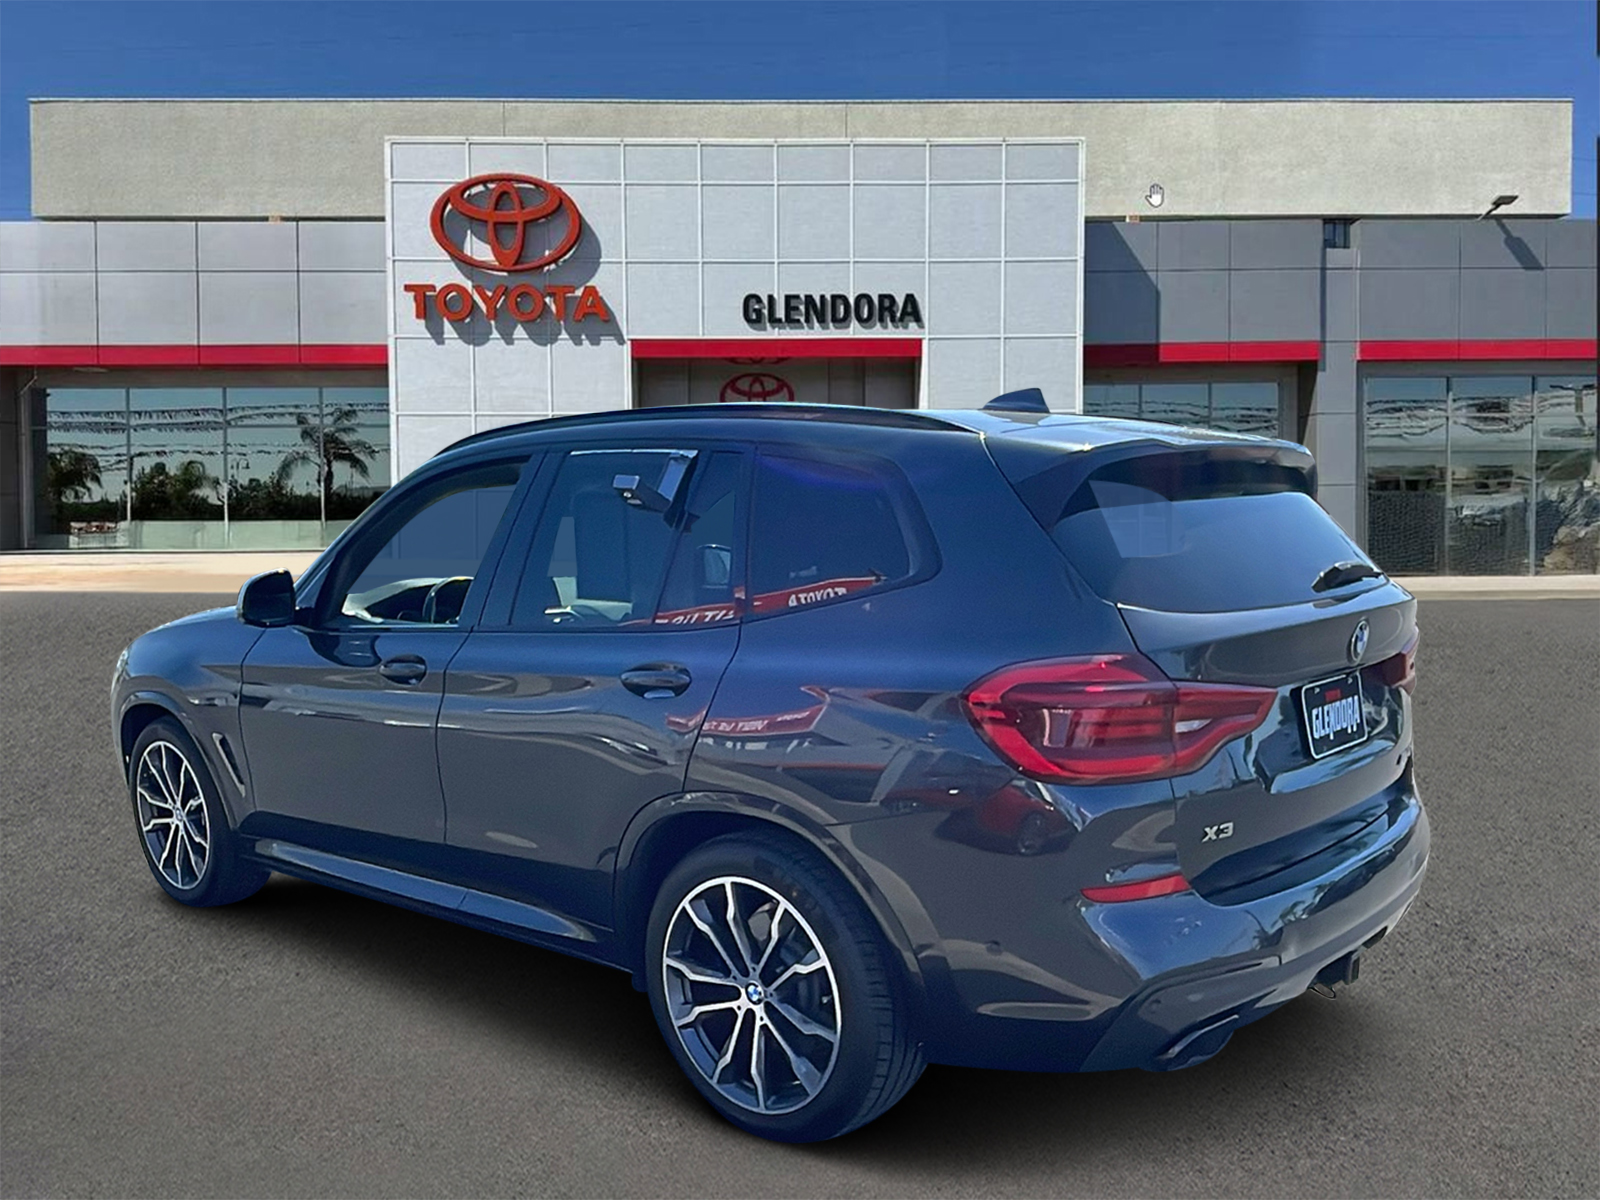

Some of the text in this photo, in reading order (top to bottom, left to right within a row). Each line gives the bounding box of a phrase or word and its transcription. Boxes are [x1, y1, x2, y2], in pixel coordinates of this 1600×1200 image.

[404, 284, 610, 324] TOYOTA
[743, 293, 923, 327] GLENDORA
[1311, 695, 1361, 740] GLENDORA
[1202, 822, 1234, 843] X3
